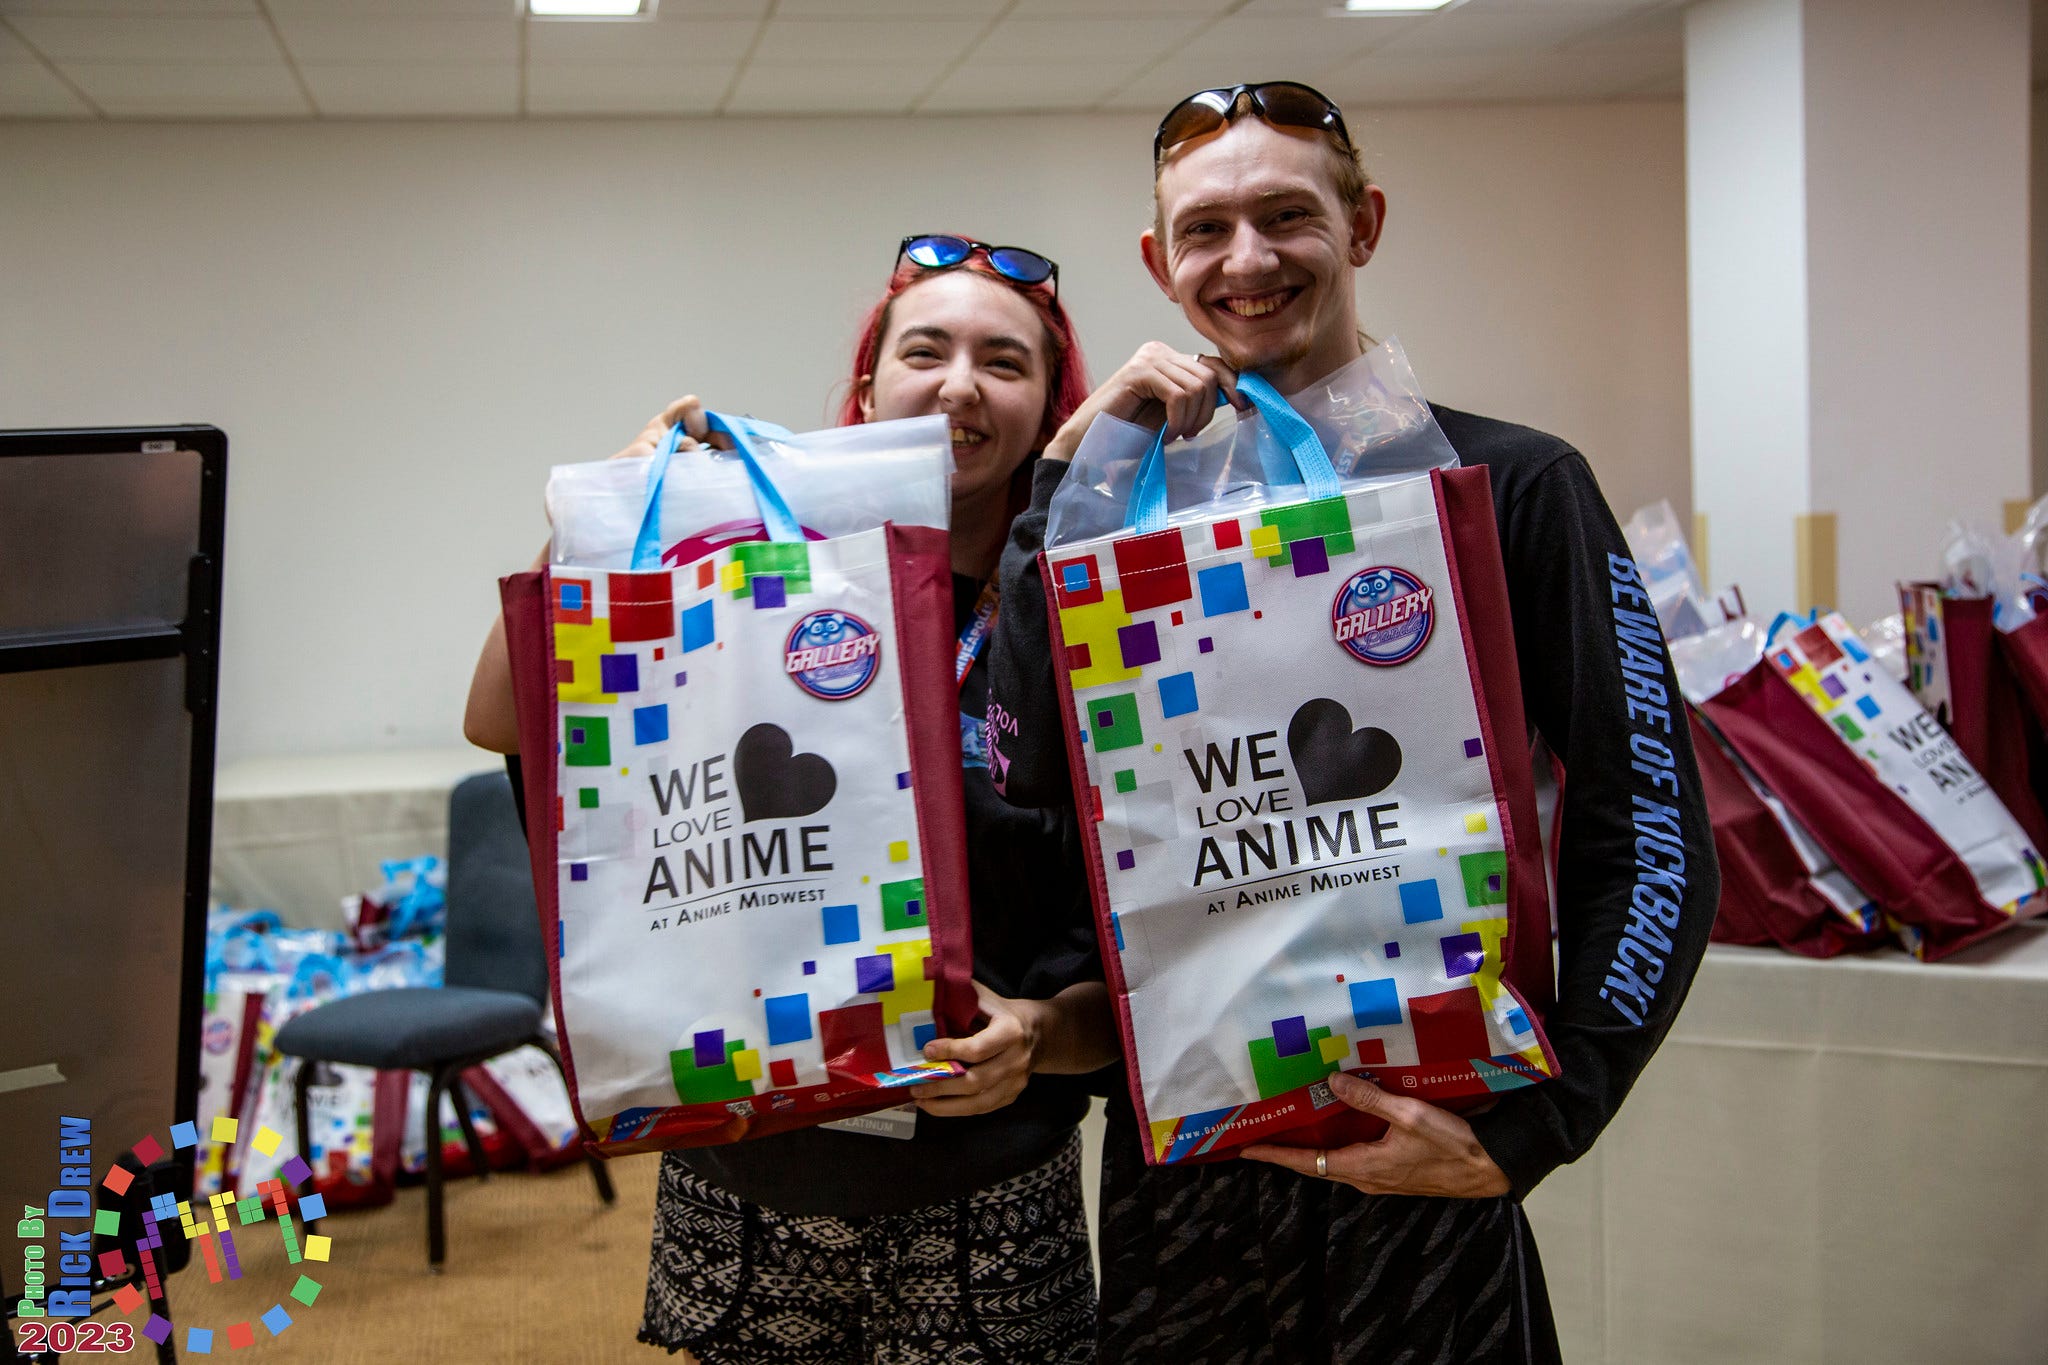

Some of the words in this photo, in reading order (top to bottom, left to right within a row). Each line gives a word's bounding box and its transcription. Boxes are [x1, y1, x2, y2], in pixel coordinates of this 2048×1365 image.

[1335, 586, 1434, 642] GALLERY
[786, 633, 881, 674] GALLERY
[1607, 551, 1671, 734] BEWARE
[1888, 711, 1942, 752] WE
[649, 754, 728, 816] WE
[1183, 730, 1285, 794] WE
[1629, 731, 1679, 797] OF
[1928, 759, 1974, 793] AN
[653, 807, 732, 848] LOVE
[1196, 788, 1293, 829] LOVE
[643, 825, 834, 904] ANIME
[1193, 802, 1407, 886] ANIME
[650, 918, 668, 932] AT
[676, 903, 731, 927] ANIME
[738, 888, 826, 911] MIDWEST
[1207, 900, 1226, 915] AT
[1236, 882, 1301, 909] ANIME
[1310, 864, 1402, 892] MIDWEST
[1598, 794, 1687, 1026] KICKBACK!
[1178, 1103, 1296, 1141] www.GalleryPanda.com
